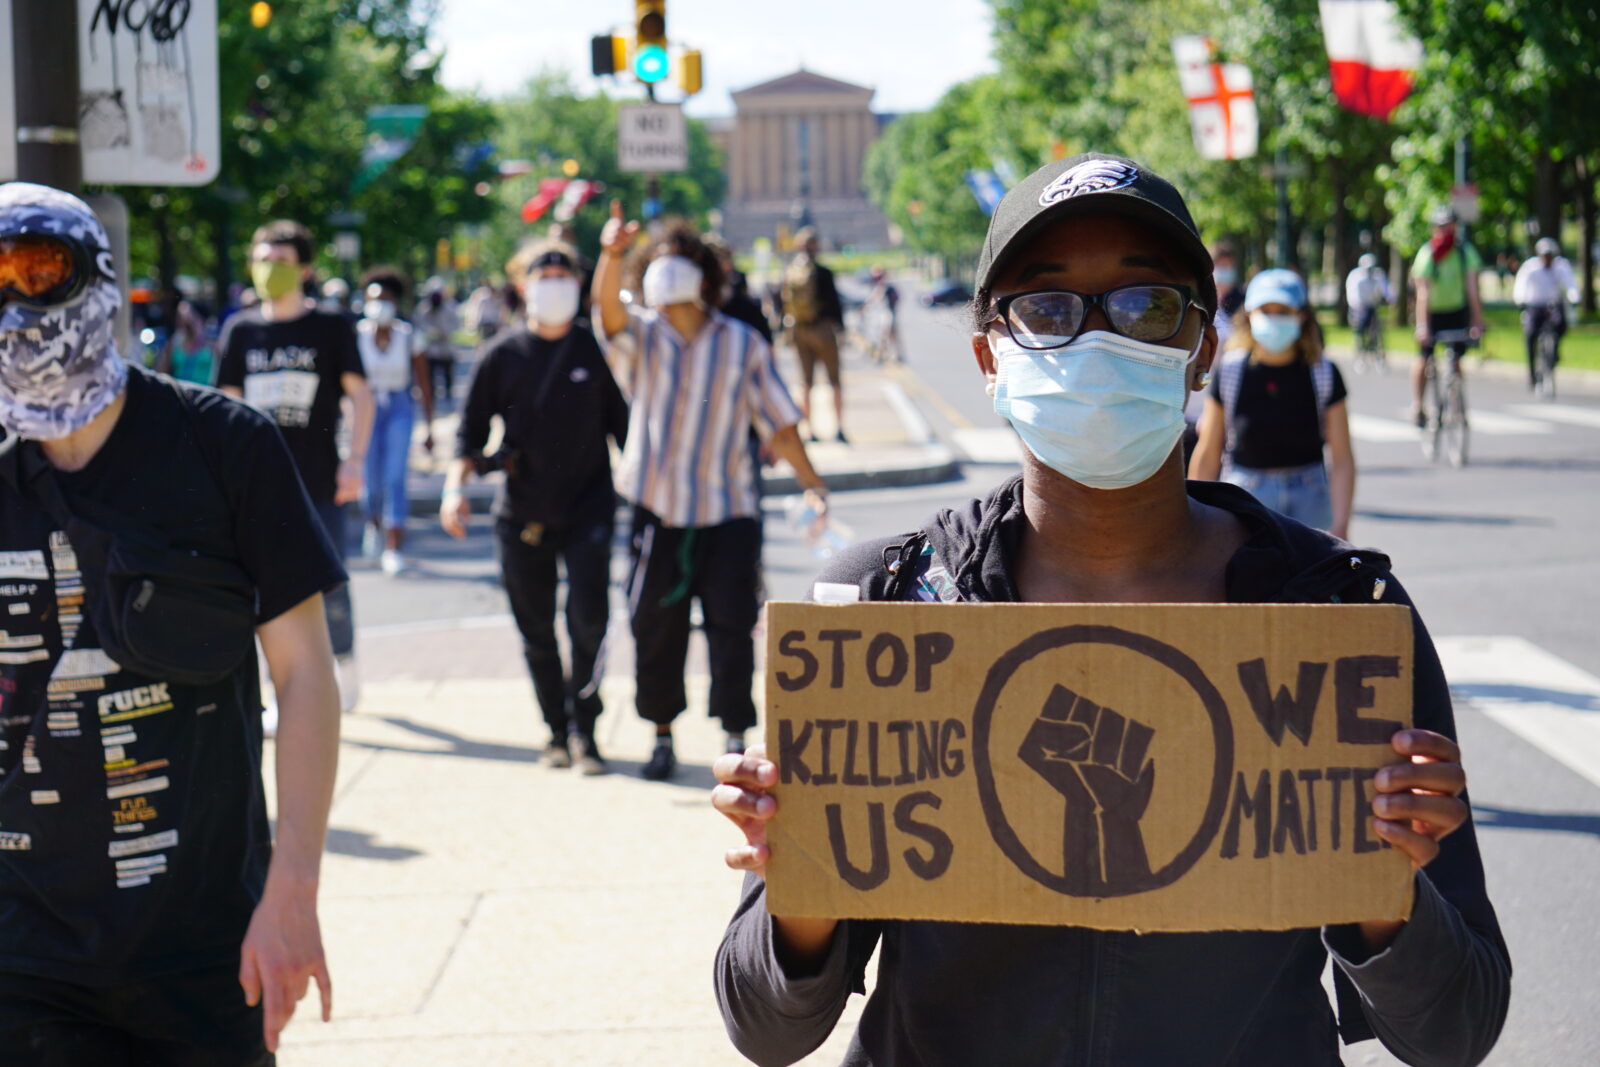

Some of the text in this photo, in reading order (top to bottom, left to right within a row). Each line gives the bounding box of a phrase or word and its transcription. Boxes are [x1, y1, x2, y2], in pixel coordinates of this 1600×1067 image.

[245, 345, 318, 373] BLACK
[775, 629, 955, 692] STOP
[97, 682, 171, 716] FUCK
[1237, 655, 1403, 747] WE
[777, 717, 967, 787] KILLING
[824, 791, 954, 892] US
[1219, 767, 1392, 860] MATTE
